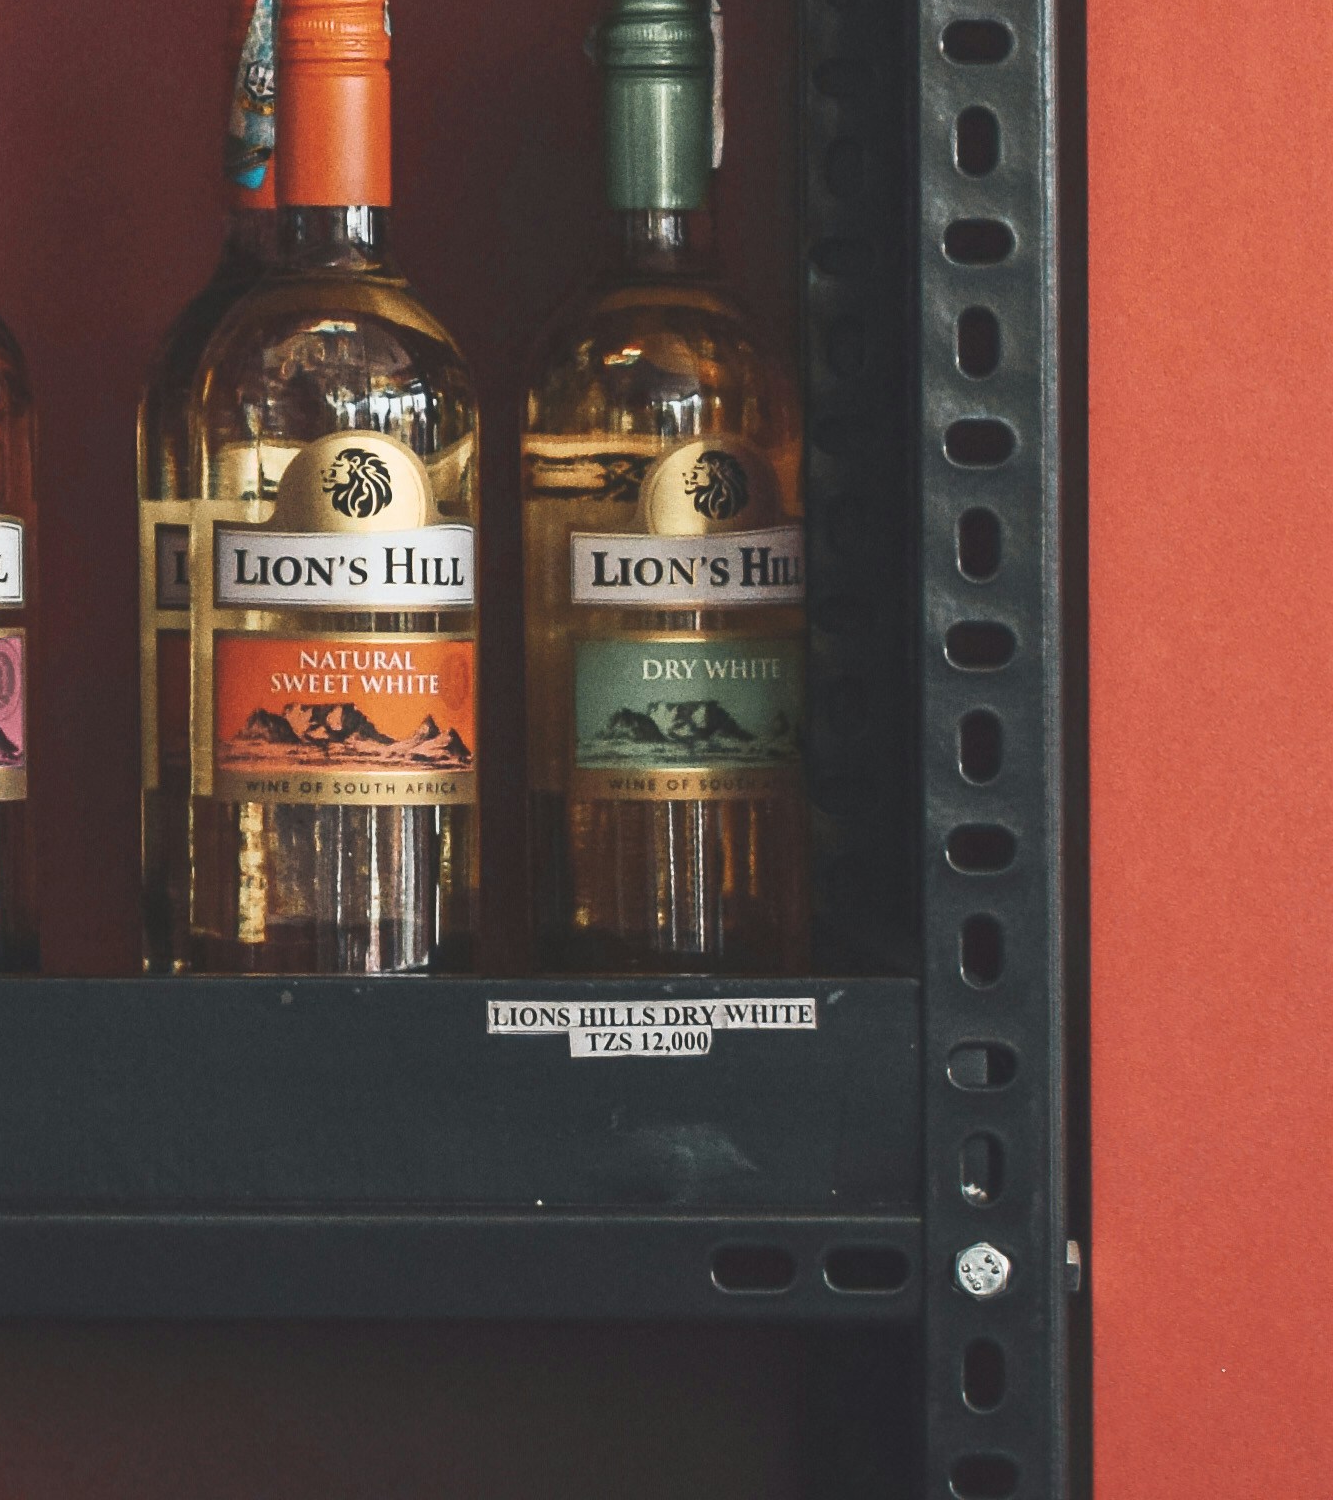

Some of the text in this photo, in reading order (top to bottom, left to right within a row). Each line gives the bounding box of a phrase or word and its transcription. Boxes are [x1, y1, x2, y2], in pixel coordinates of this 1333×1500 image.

[234, 548, 368, 586] LION'S
[383, 547, 464, 586] HILL
[591, 546, 803, 587] LION'S HILL
[299, 650, 416, 671] NATURAL
[642, 658, 781, 681] DRY WHITE
[270, 674, 439, 694] SWEET WHITE
[246, 779, 457, 795] WINE OF SOUTH AFRICA
[667, 779, 688, 791] OF
[492, 1003, 813, 1027] LIONS HILLS DRY WHITE
[585, 1031, 709, 1053] TZS 12,000
